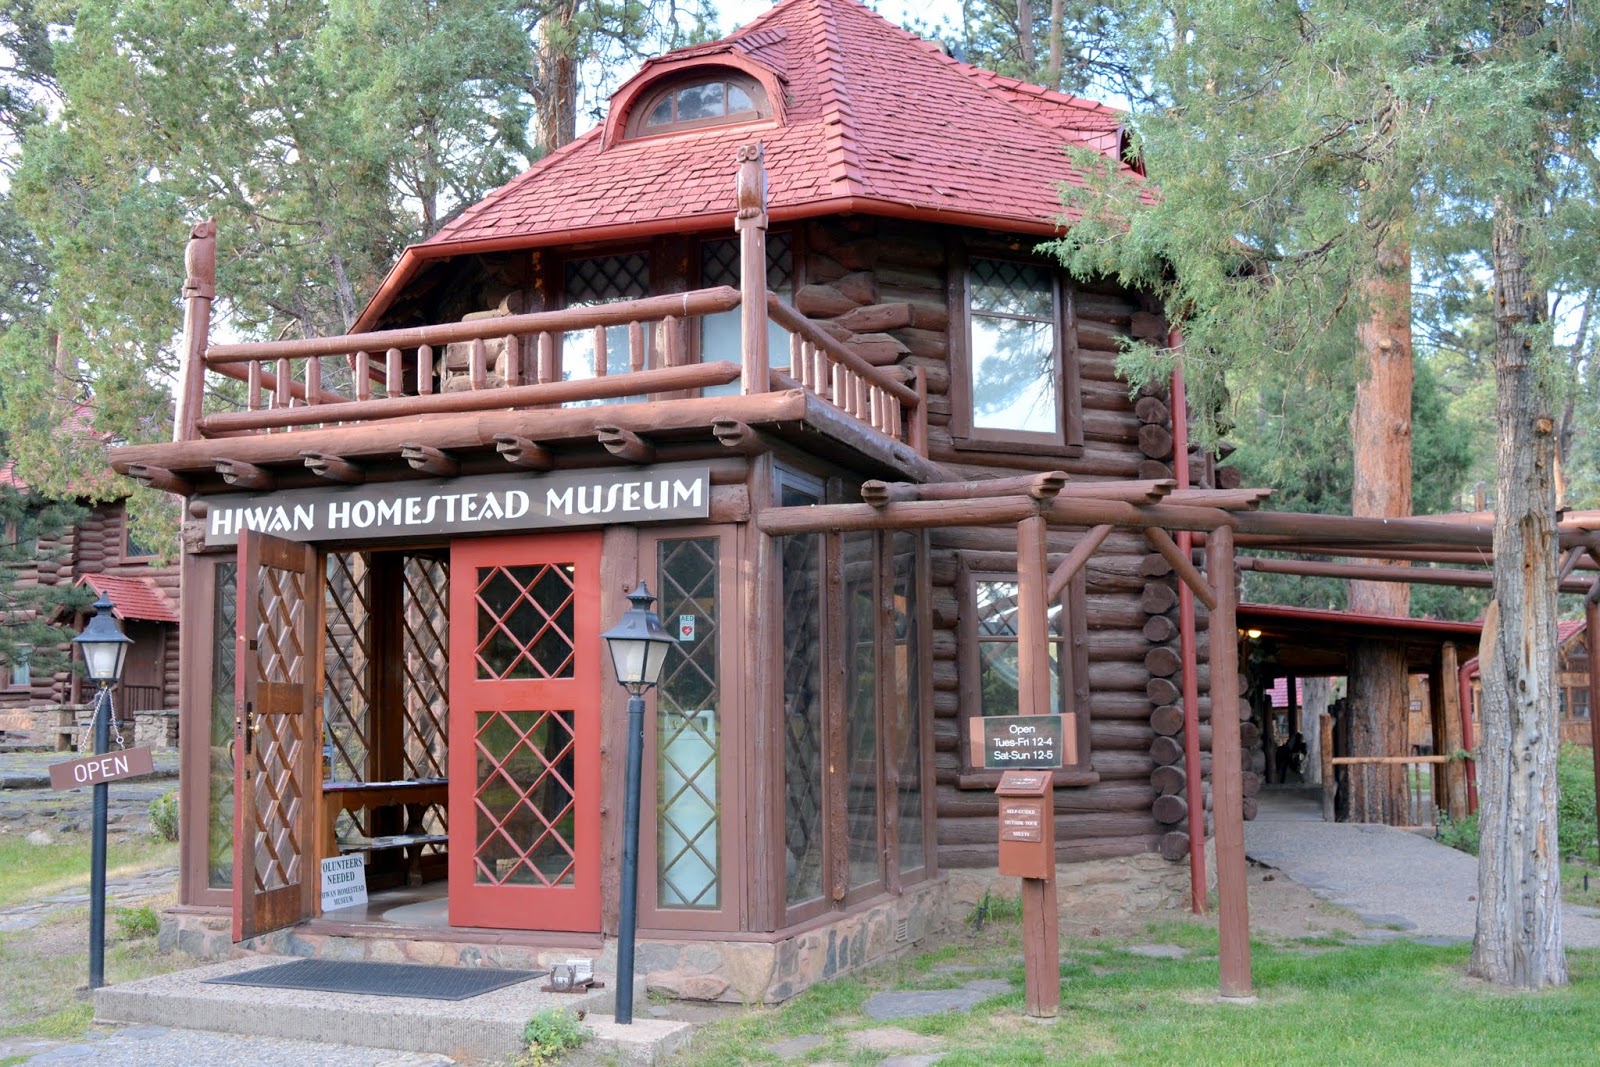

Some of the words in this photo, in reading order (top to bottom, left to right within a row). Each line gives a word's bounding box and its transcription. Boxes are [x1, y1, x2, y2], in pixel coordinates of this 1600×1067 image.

[211, 504, 314, 535] HIWAN
[327, 489, 529, 529] HOMESTEAD
[546, 478, 702, 517] MUSEUM
[1009, 724, 1036, 735] Open
[994, 737, 1030, 747] Tues-Fri
[1032, 737, 1053, 746] 12-4
[994, 750, 1031, 760] Sat-Sun
[1033, 750, 1054, 760] 12-5
[74, 755, 129, 782] OPEN
[322, 857, 363, 873] OLUNTEERS
[327, 871, 355, 885] NEEDED
[321, 890, 336, 899] IWAN
[337, 885, 365, 896] HOMESTEAD
[333, 895, 353, 905] MUSEUM
